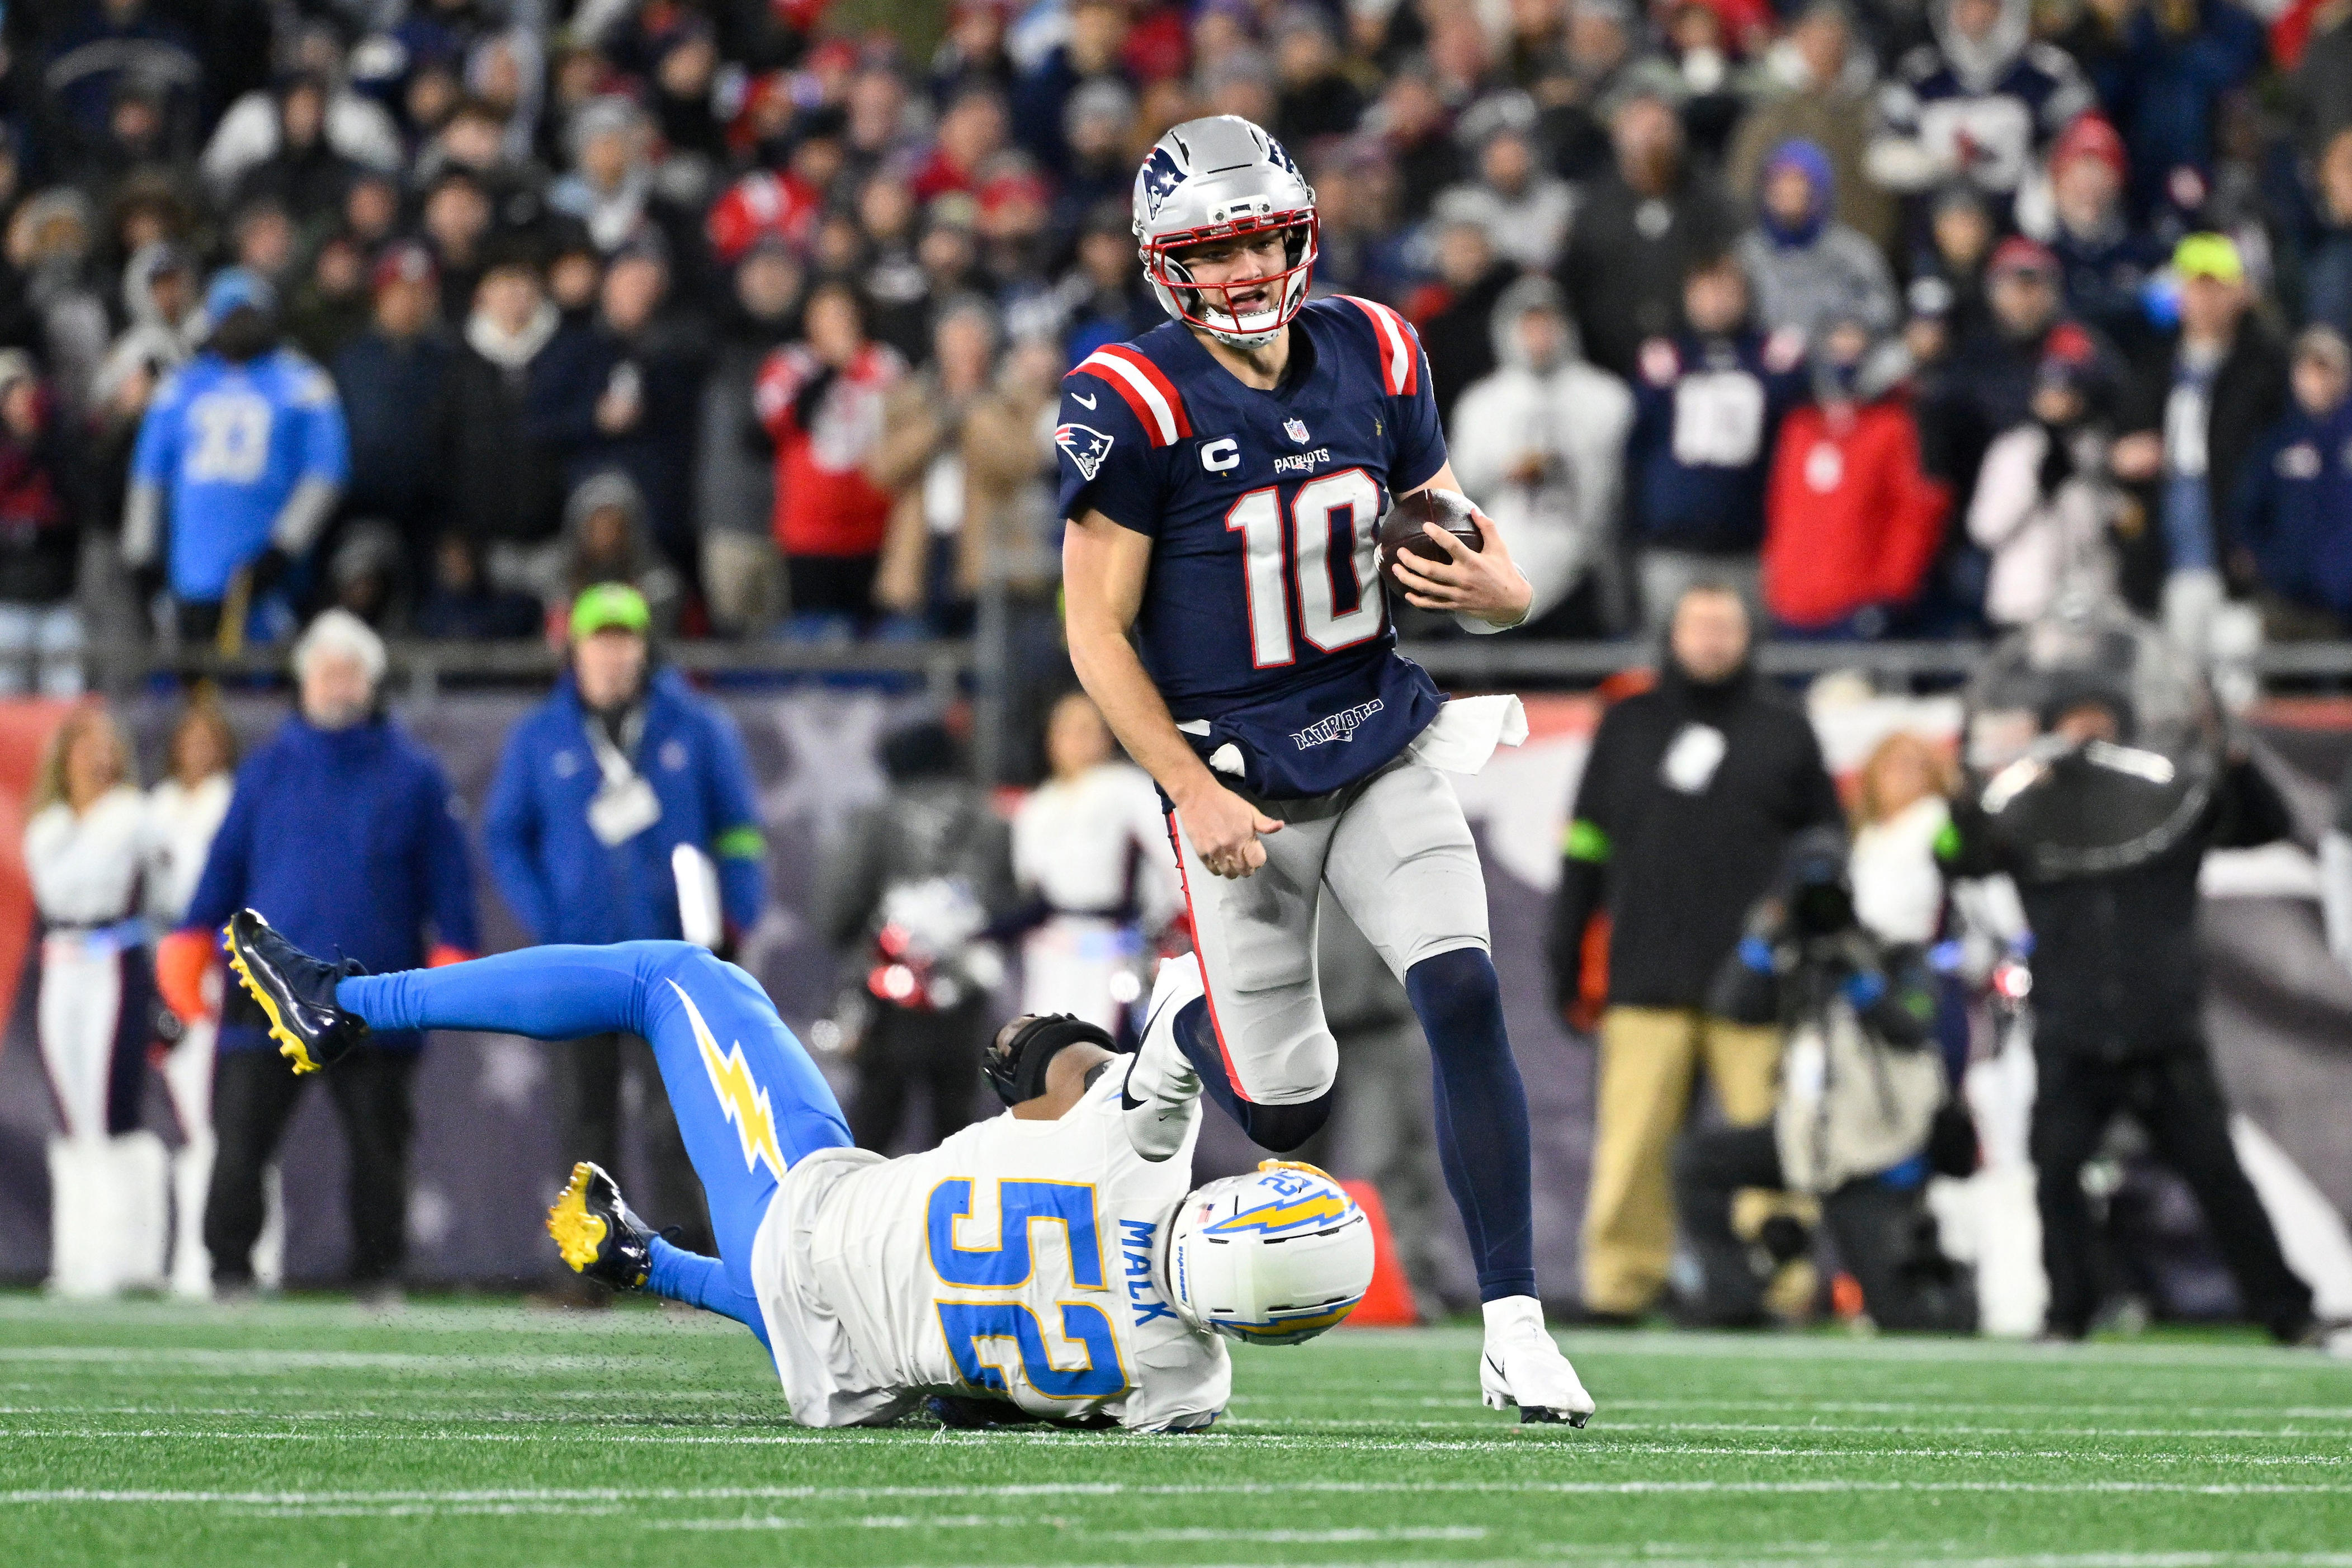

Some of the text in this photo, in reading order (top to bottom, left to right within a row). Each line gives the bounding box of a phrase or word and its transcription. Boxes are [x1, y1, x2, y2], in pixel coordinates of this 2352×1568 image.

[1201, 438, 1240, 472] C
[1274, 448, 1330, 474] PATRIOTS
[1225, 467, 1384, 669] 10
[924, 1176, 1130, 1400] 52
